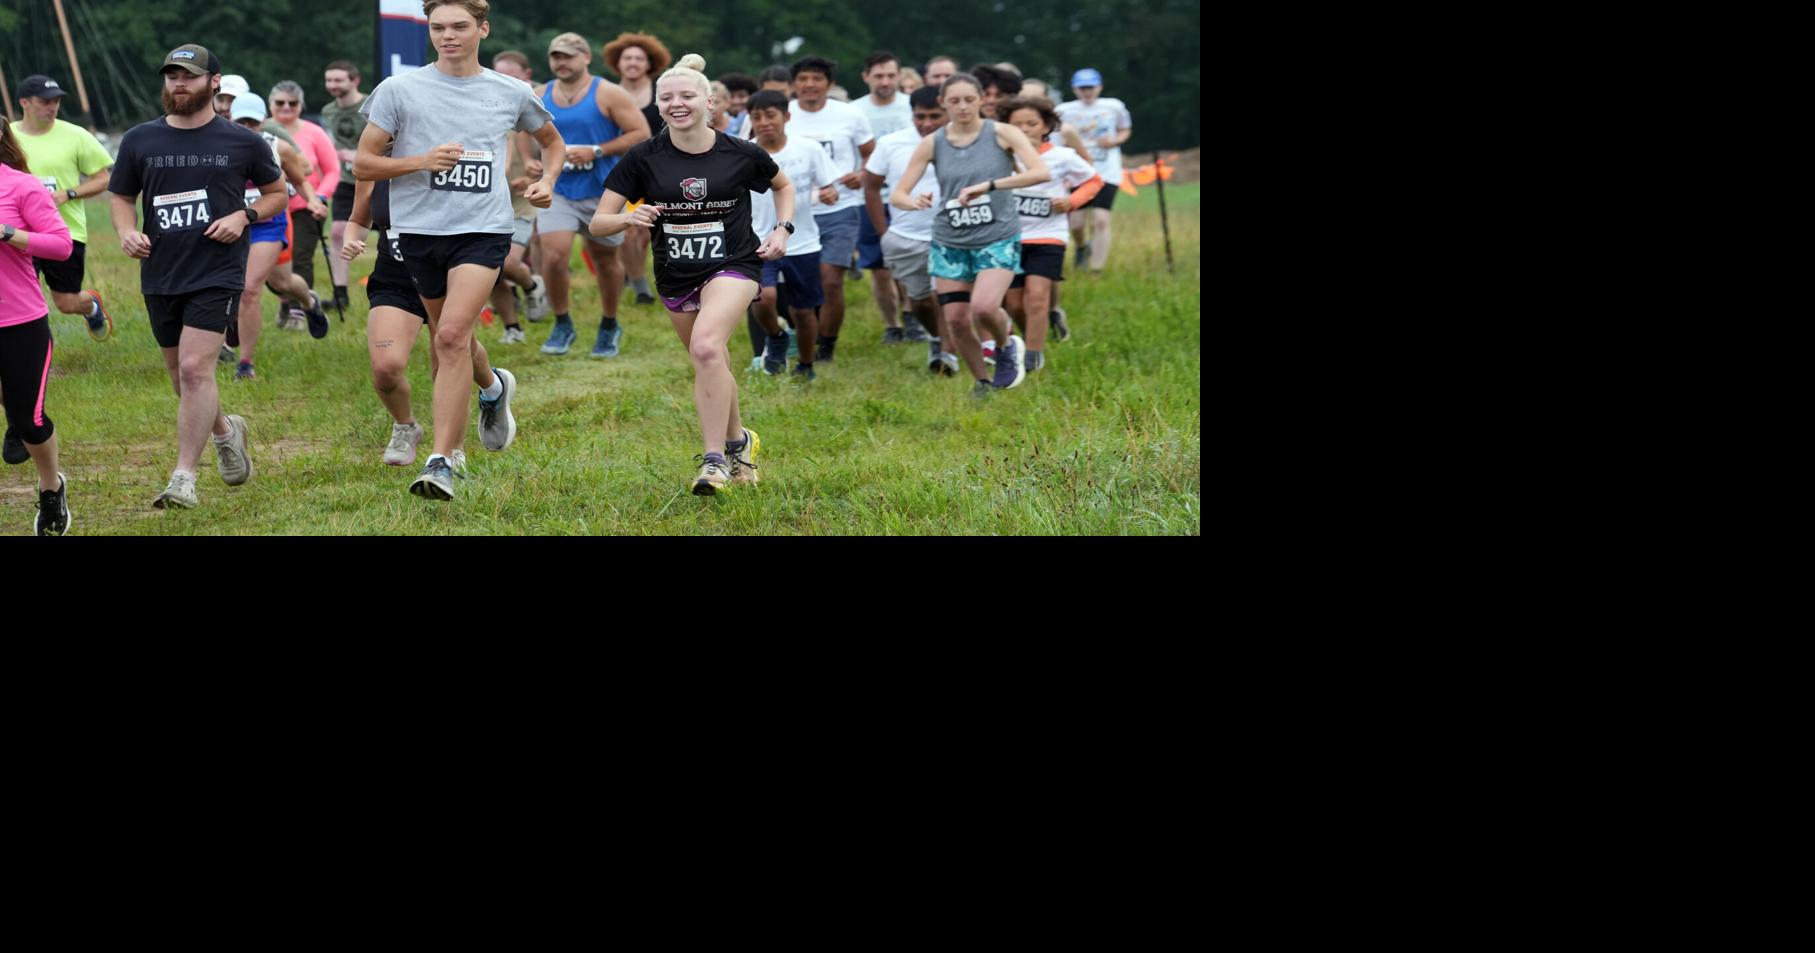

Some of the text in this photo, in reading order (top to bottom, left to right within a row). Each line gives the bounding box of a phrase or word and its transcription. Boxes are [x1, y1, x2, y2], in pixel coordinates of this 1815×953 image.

[145, 154, 229, 168] FREEDOM
[434, 164, 490, 188] 3450
[705, 198, 738, 209] ABBEY
[157, 202, 210, 230] 3474
[949, 205, 993, 228] 3459
[667, 235, 724, 260] 3472
